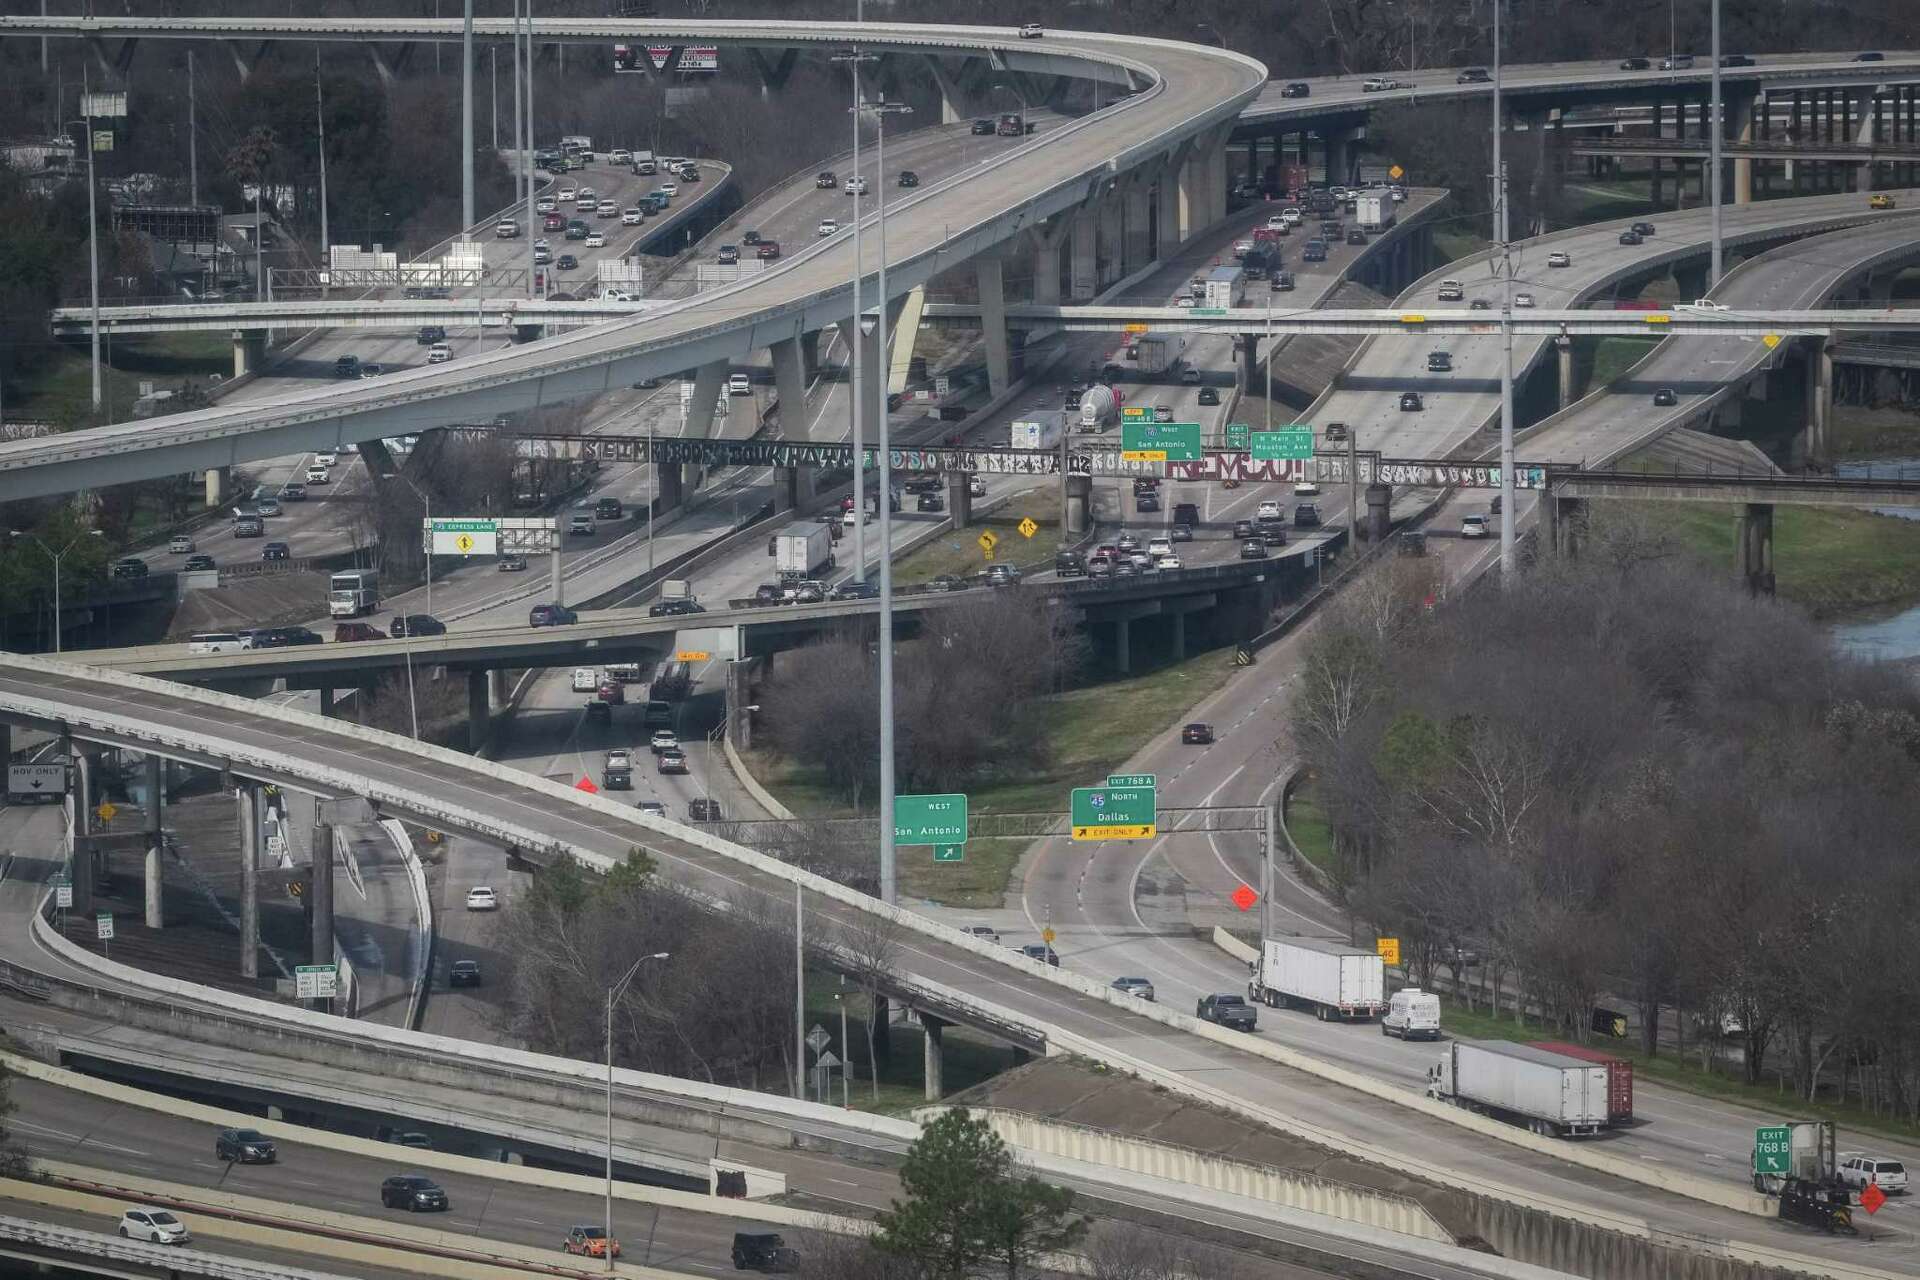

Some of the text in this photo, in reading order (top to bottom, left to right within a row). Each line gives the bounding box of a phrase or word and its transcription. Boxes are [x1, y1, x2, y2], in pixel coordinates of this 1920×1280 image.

[12, 767, 59, 775] HOV ONLY
[1127, 777, 1144, 785] 768
[1146, 777, 1152, 785] A
[1091, 796, 1105, 807] 45
[1111, 793, 1138, 801] NORTH
[1098, 812, 1130, 822] Dallas
[895, 826, 961, 836] San Antonio
[1383, 950, 1394, 958] 40
[1762, 1131, 1784, 1140] EXIT
[1757, 1142, 1789, 1153] 768 B
